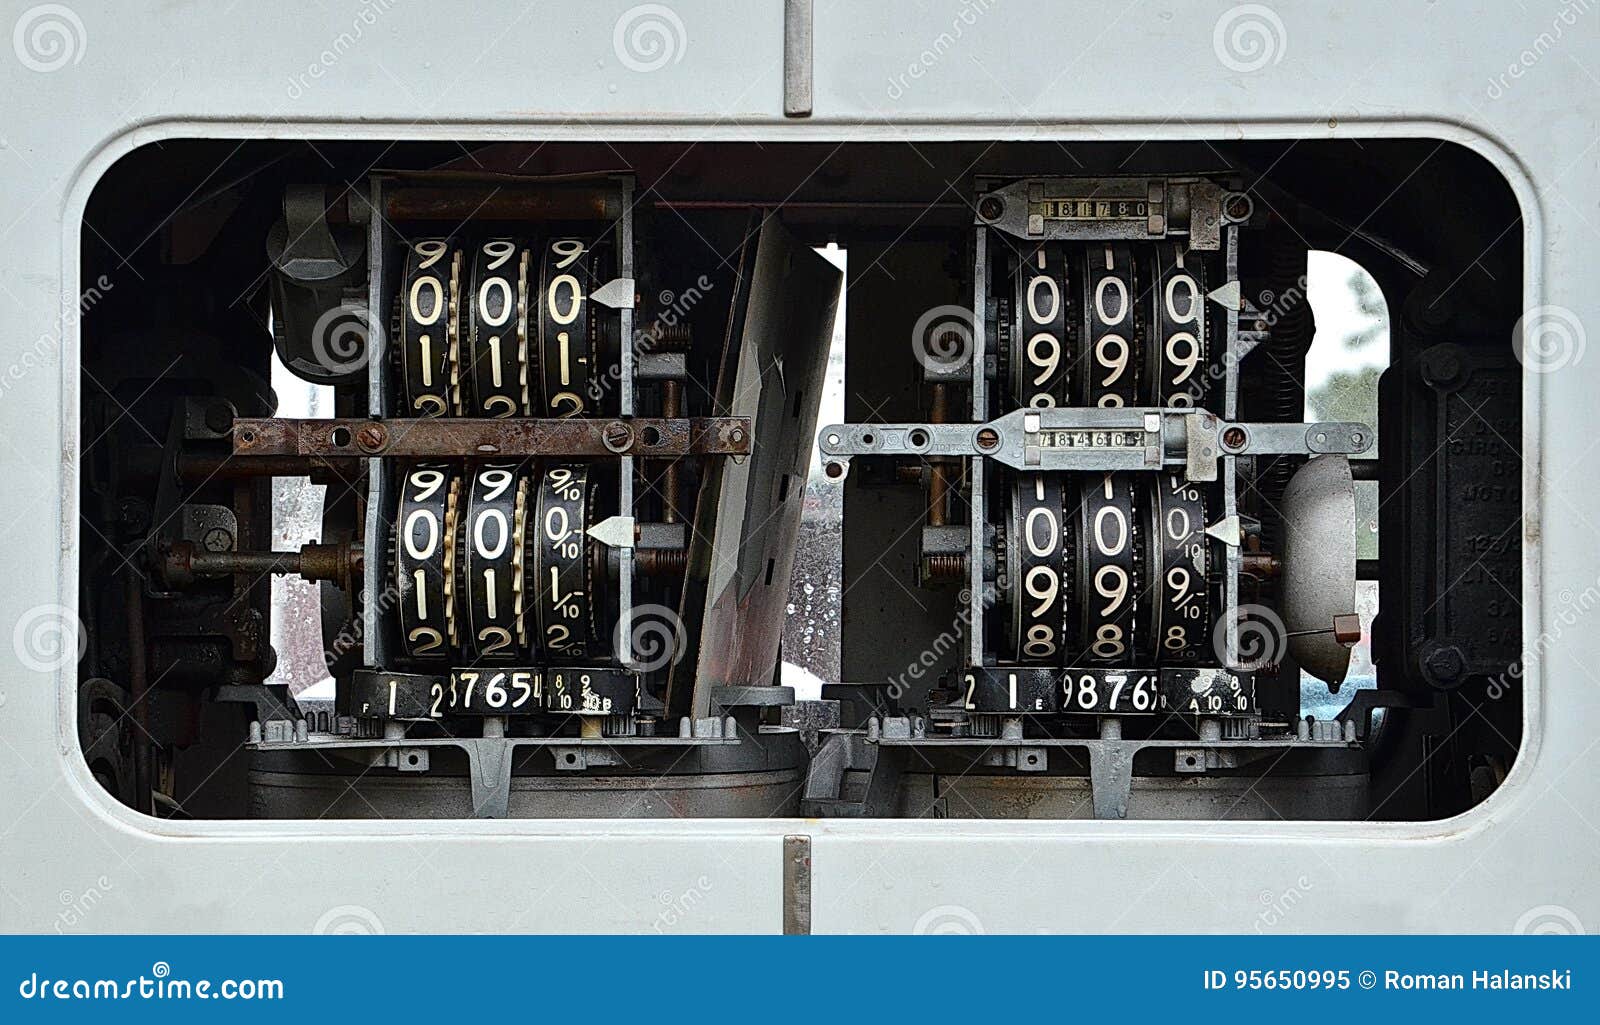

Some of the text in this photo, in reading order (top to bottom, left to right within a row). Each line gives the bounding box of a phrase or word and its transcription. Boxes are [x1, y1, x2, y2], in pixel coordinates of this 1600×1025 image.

[415, 241, 585, 270] 9 9 9
[411, 275, 582, 327] 0 0 0
[1027, 274, 1200, 325] 0 0 0
[418, 333, 570, 387] 1 1 1
[1027, 332, 1200, 387] 9 9 9
[411, 470, 444, 502] 9
[480, 470, 513, 502] 9
[404, 508, 439, 560] 0
[474, 508, 508, 560] 0
[1025, 507, 1058, 557] 0
[1094, 506, 1127, 556] 0
[414, 568, 427, 620] 1
[483, 568, 496, 620] 1
[1025, 566, 1059, 618] 9
[1094, 565, 1129, 617] 9
[409, 627, 443, 656] 2
[478, 627, 512, 656] 2
[1023, 624, 1056, 657] 8
[1092, 624, 1125, 658] 8
[362, 681, 443, 719] F 1 2
[964, 673, 1043, 710] 2 1 E
[1189, 699, 1199, 710] A
